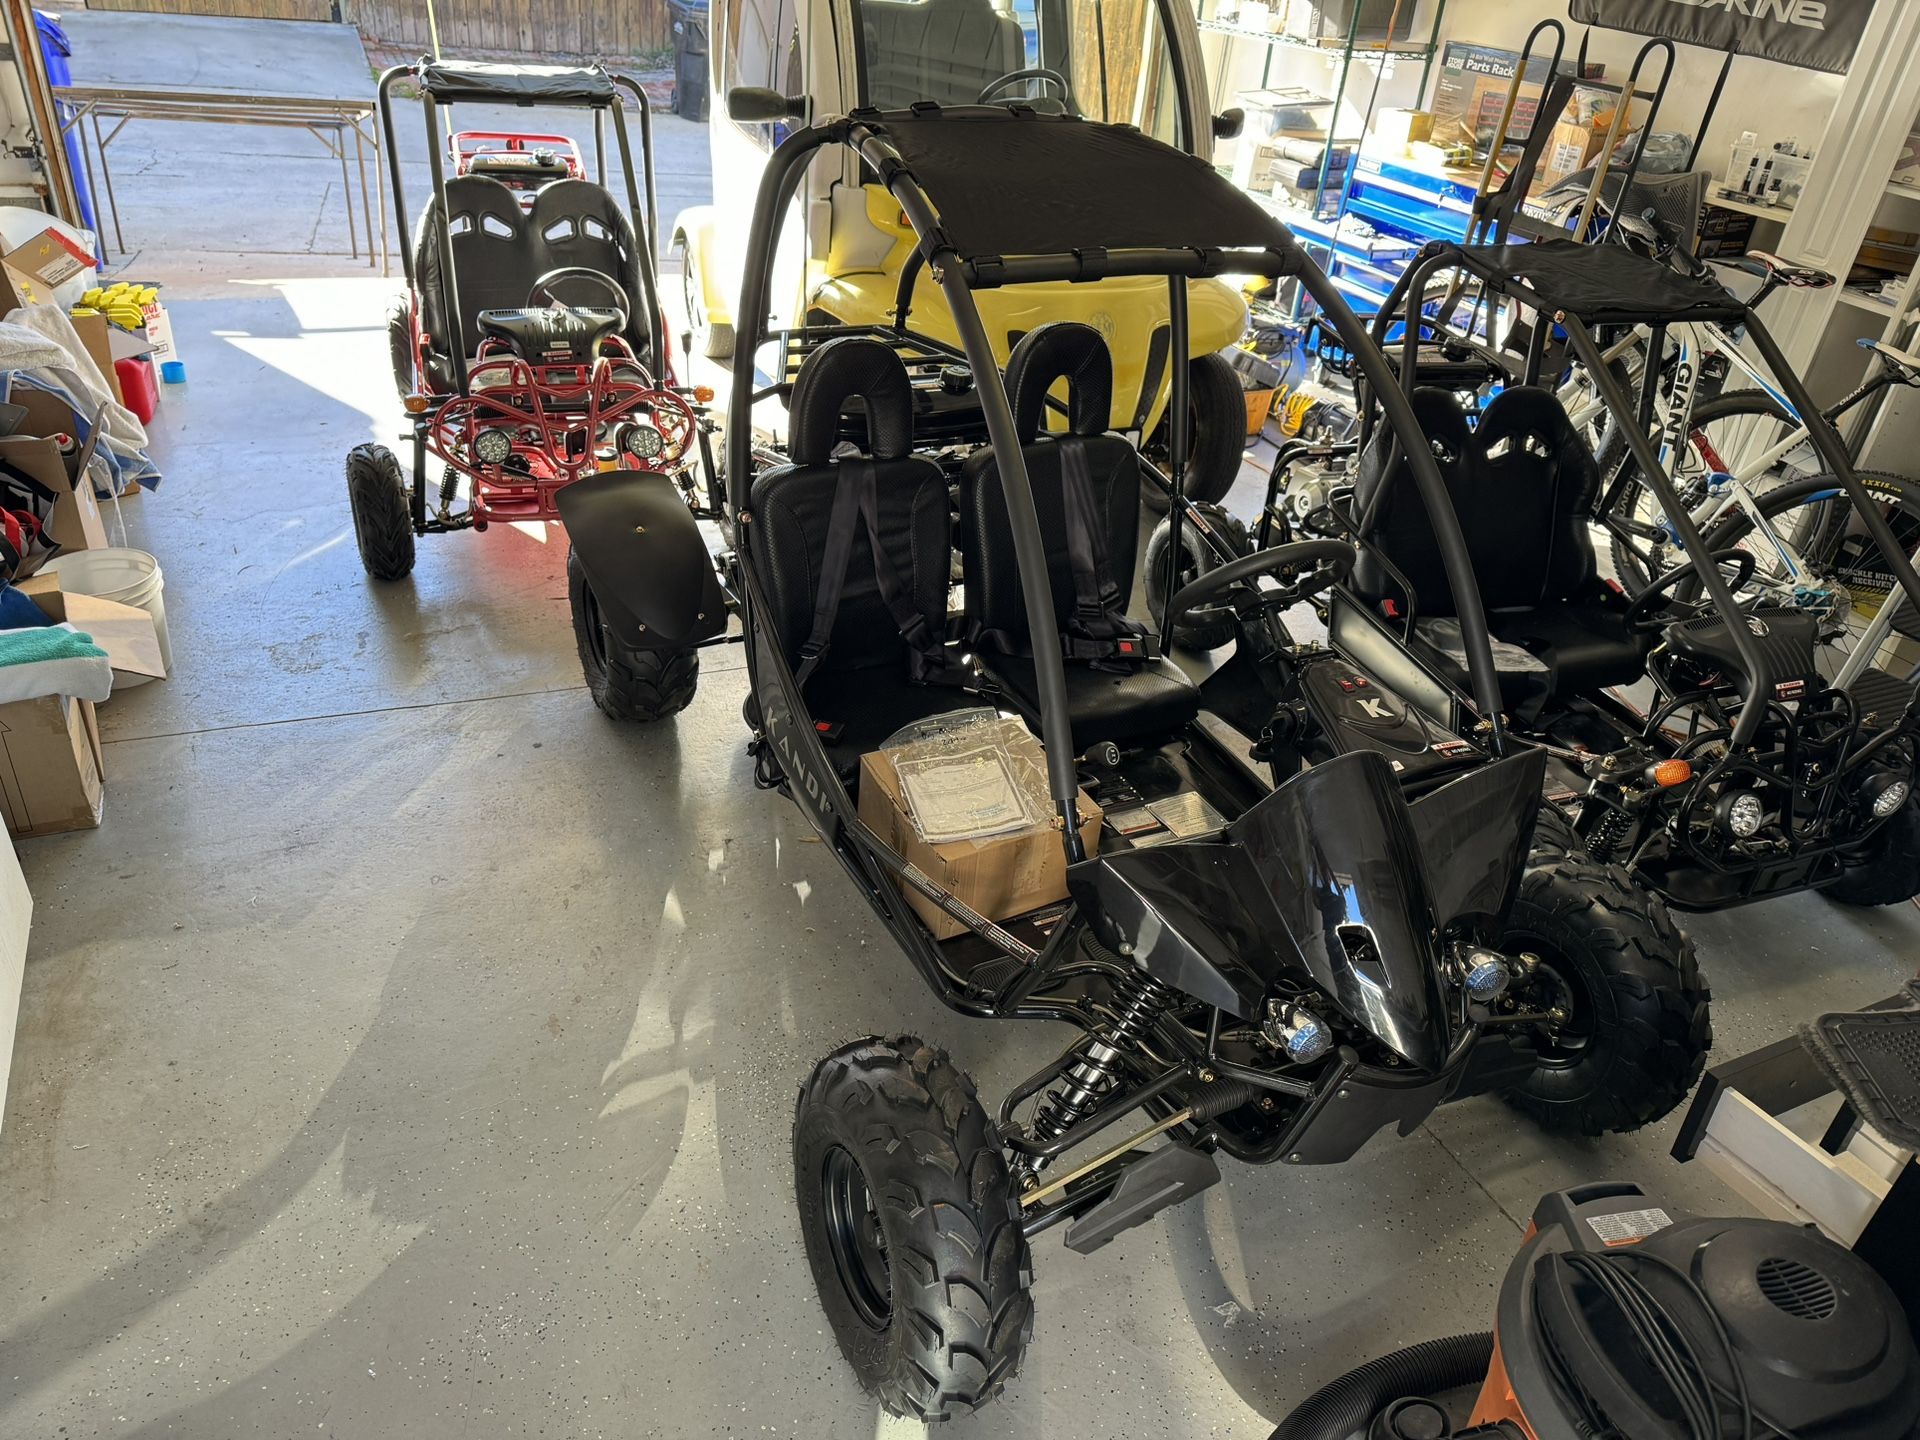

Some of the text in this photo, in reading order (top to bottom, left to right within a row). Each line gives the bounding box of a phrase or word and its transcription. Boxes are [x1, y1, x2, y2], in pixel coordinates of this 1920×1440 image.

[1668, 0, 1828, 31] KINe
[1466, 59, 1515, 77] Parts Rack
[1839, 383, 1866, 405] GIANT
[1664, 363, 1692, 452] GIANT
[1861, 480, 1902, 493] AXXIS.com
[1620, 481, 1634, 517] UARO
[1838, 567, 1873, 578] SHACKLE
[1852, 576, 1893, 588] RECEIVER
[1356, 698, 1395, 718] K
[766, 706, 827, 812] KANDI
